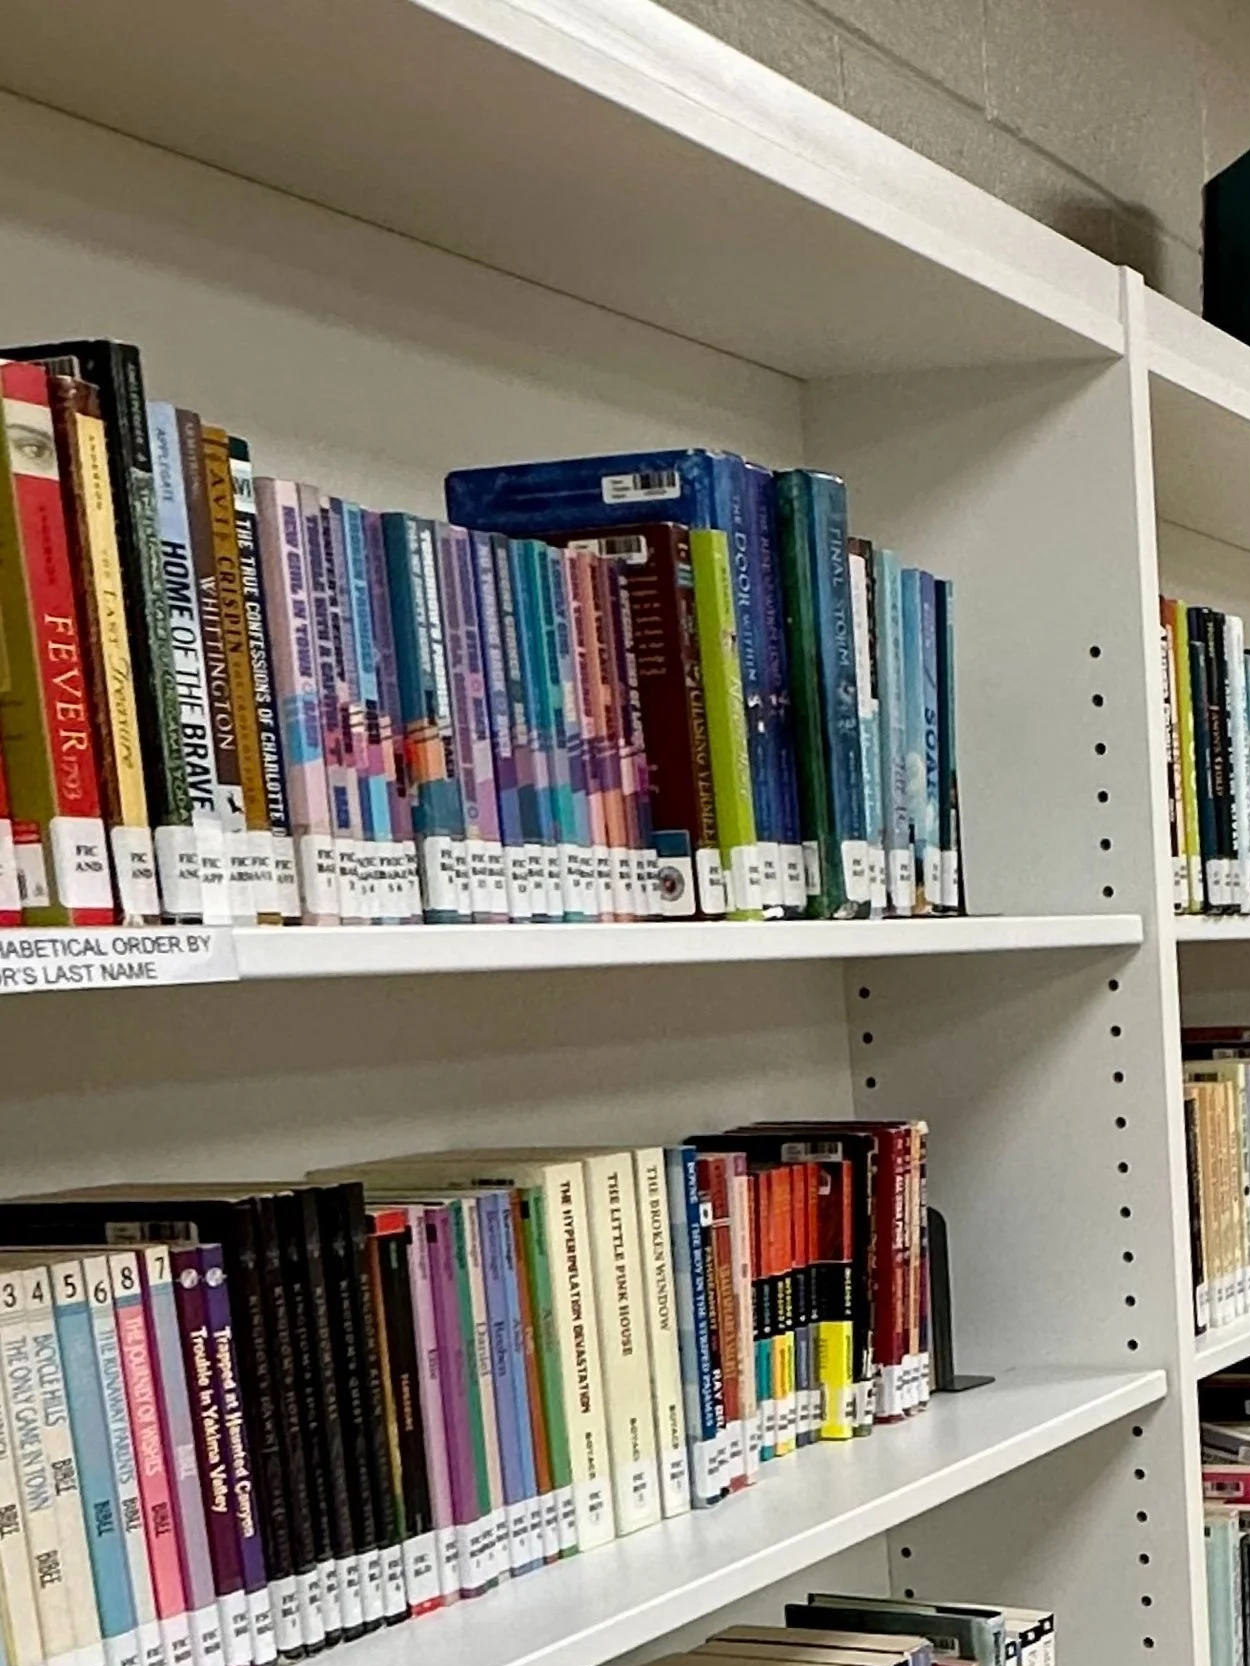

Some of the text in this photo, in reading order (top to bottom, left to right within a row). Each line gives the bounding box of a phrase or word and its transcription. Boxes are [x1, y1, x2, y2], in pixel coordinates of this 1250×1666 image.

[236, 520, 254, 551] THE
[240, 557, 260, 597] TRUE
[201, 576, 236, 751] WHITTINGTON
[245, 602, 271, 704] CONFESSIONS
[44, 613, 87, 752] FEVER
[161, 540, 216, 813] HOME OF THE BRAVE
[257, 708, 275, 728] OF
[260, 730, 284, 822] CHARLOTTE
[75, 844, 98, 857] FIC
[75, 861, 103, 873] AND
[112, 935, 182, 956] ORDER
[187, 934, 212, 952] BY
[44, 963, 95, 984] LAST
[101, 961, 158, 981] NAME
[607, 1172, 633, 1357] THE LITTLE PINK HOUSE
[646, 1165, 670, 1331] THE BROKEN WINDOW
[120, 1266, 134, 1290] 8
[153, 1255, 164, 1280] 7
[3, 1283, 17, 1308] 3
[31, 1280, 44, 1304] 4
[62, 1273, 77, 1299] 5
[93, 1280, 108, 1304] 6
[560, 1180, 572, 1205] THE
[572, 1324, 591, 1414] DEVASTATION
[189, 1327, 213, 1386] Trouble
[213, 1326, 236, 1388] Trapped
[712, 1368, 724, 1399] RAY
[16, 1409, 43, 1448] GAME
[222, 1413, 249, 1477] Haunted
